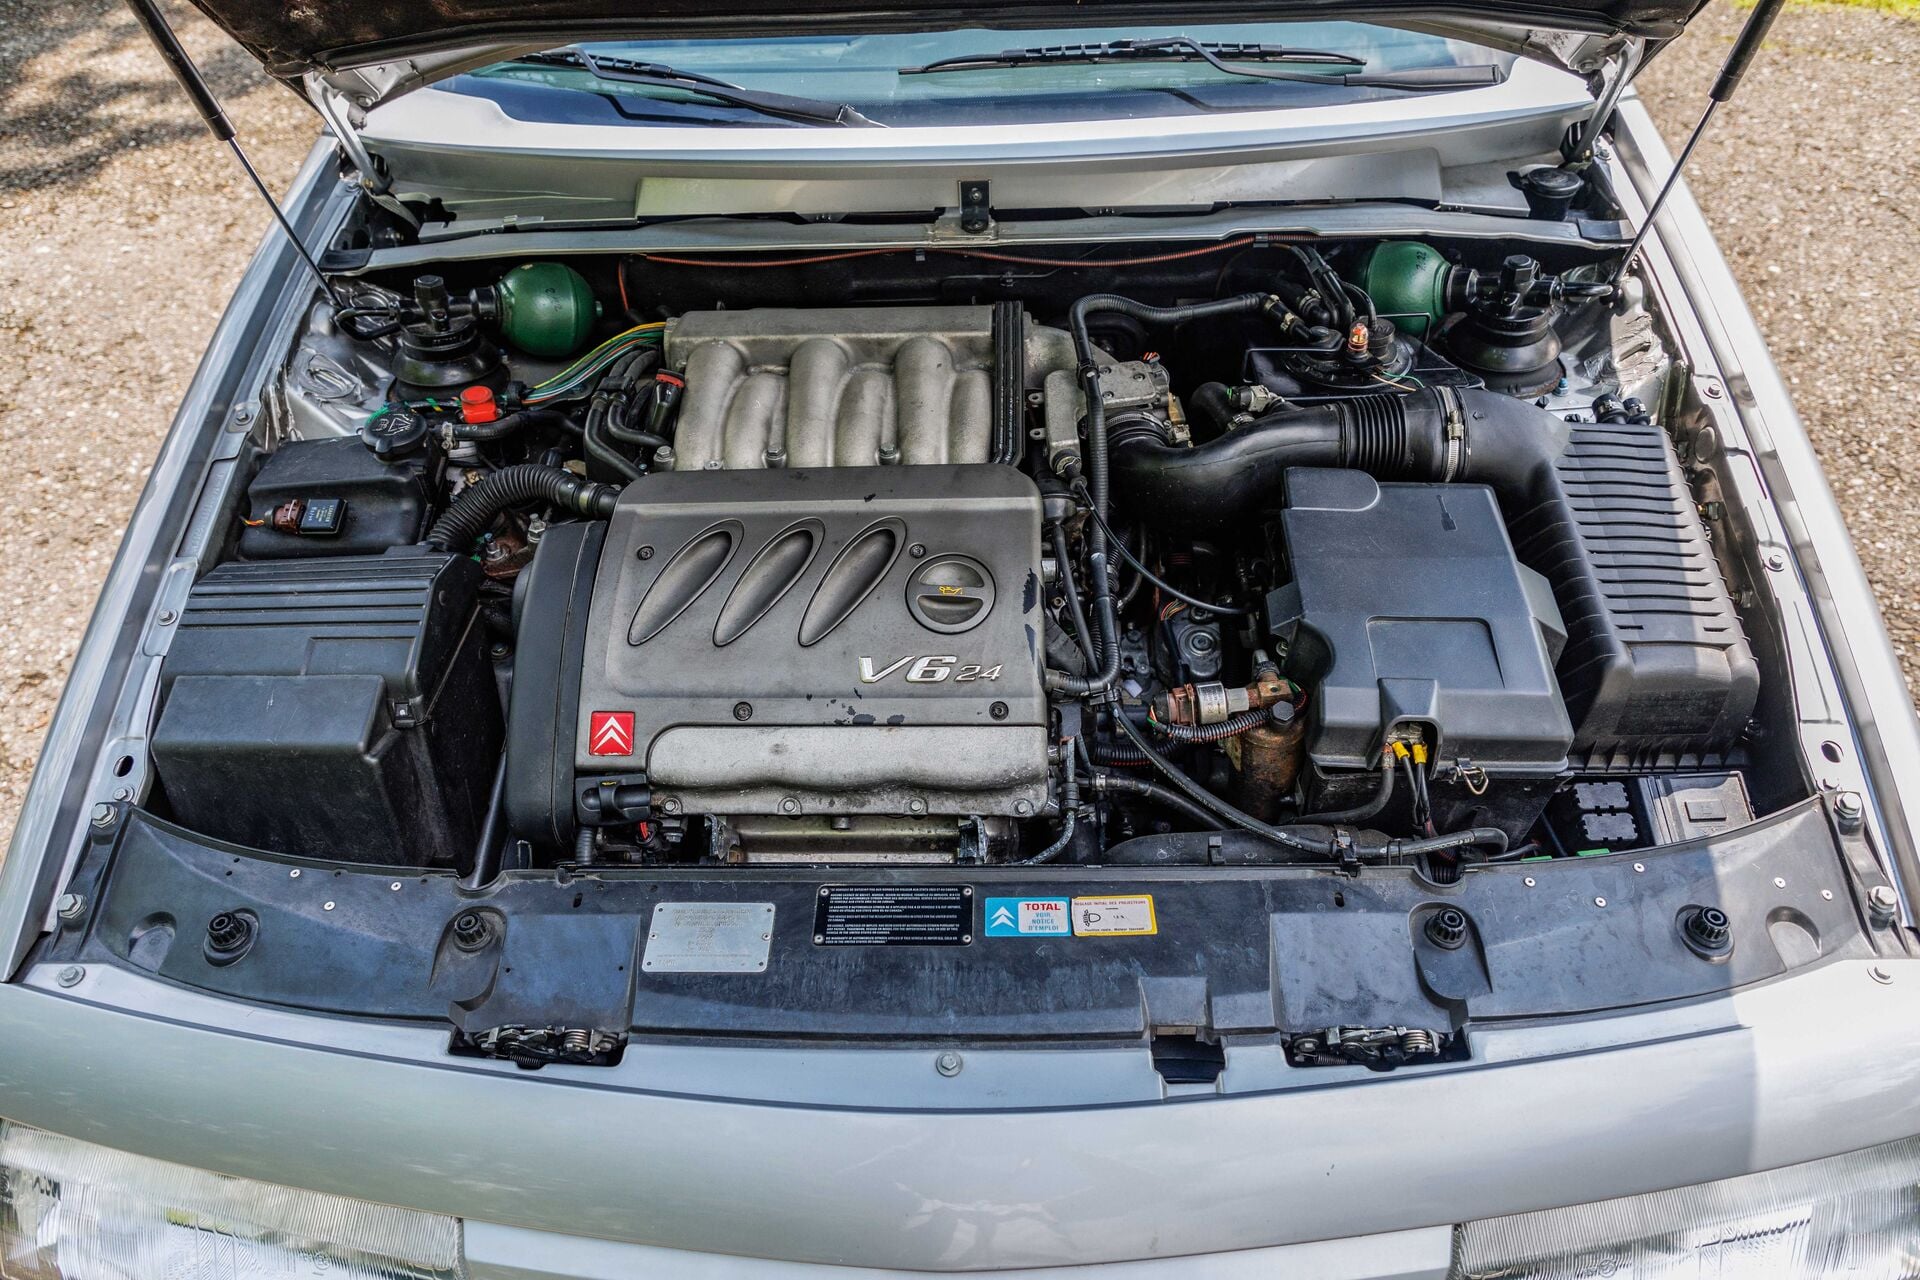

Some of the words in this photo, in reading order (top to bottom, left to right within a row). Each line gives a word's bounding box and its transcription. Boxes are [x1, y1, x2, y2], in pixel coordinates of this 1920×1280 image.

[859, 654, 957, 684] V6
[954, 664, 1004, 682] 24
[1025, 903, 1061, 911] TOTAL
